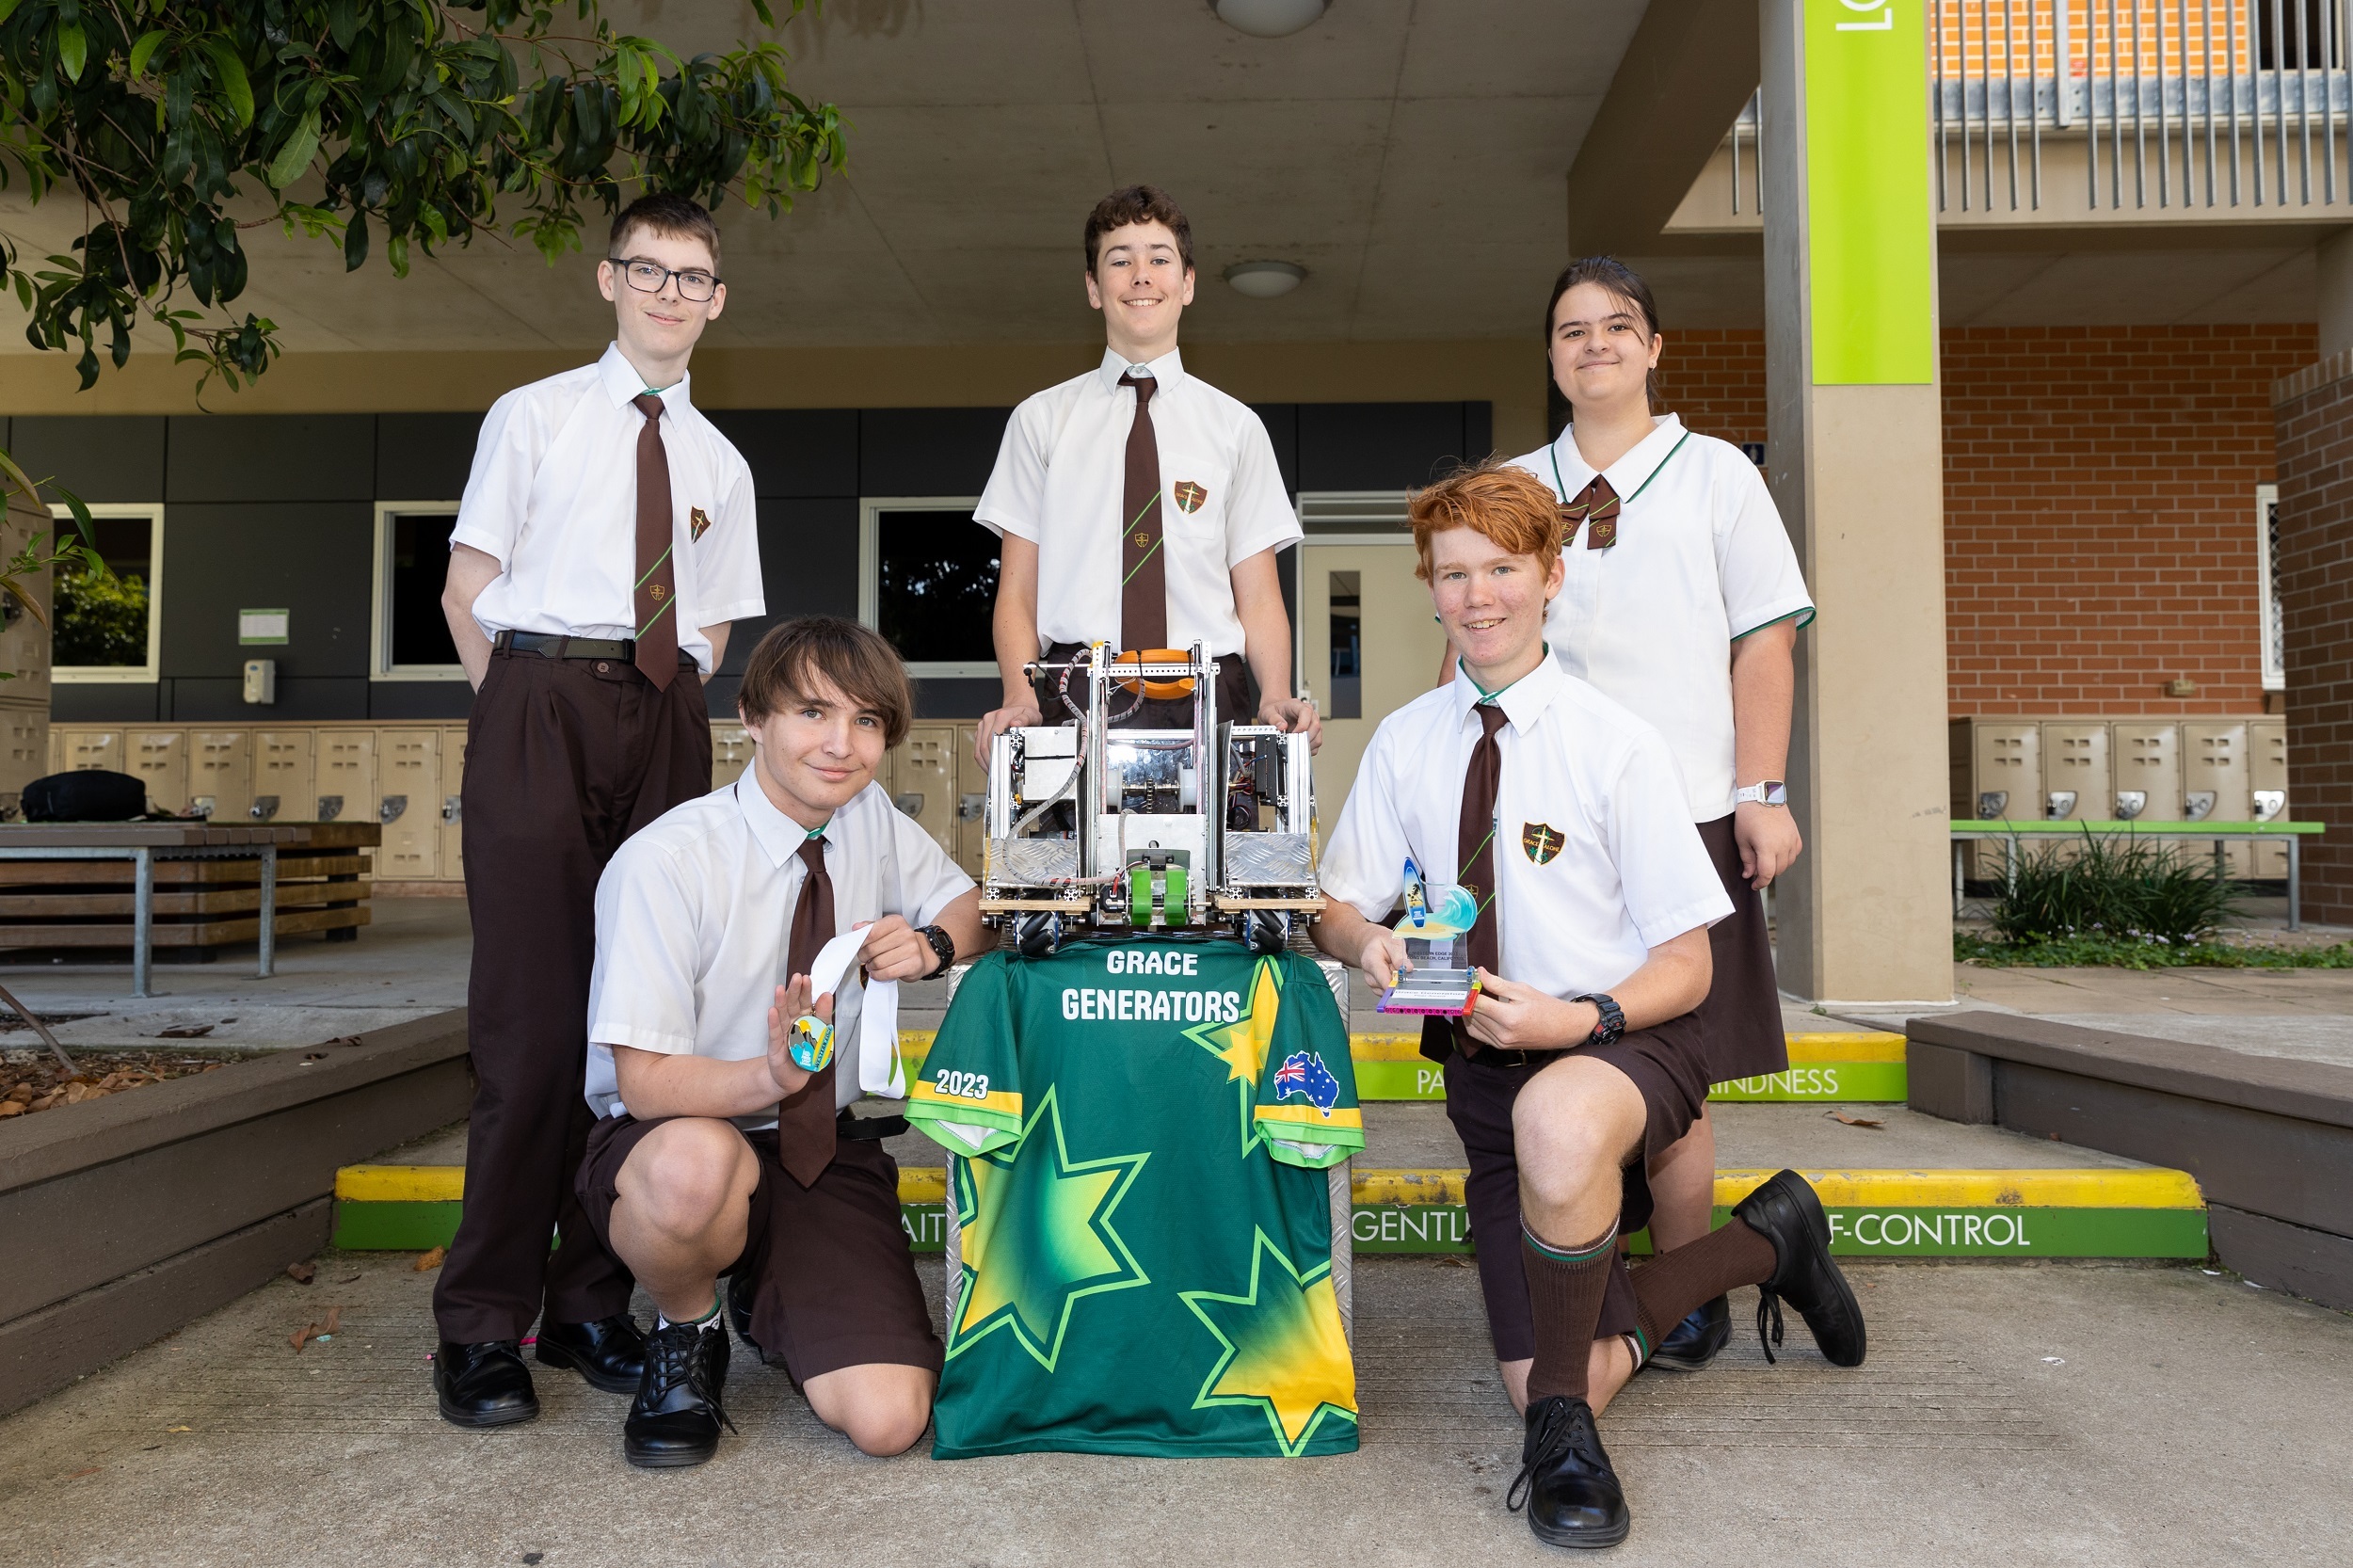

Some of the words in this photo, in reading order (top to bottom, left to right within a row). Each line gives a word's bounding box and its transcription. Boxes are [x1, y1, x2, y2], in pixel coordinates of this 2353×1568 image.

[1835, 0, 1893, 31] L
[1523, 838, 1540, 846] GRACE
[1107, 951, 1198, 976] GRACE
[1062, 988, 1241, 1023] GENERATORS
[935, 1068, 989, 1099] 2023
[1709, 1068, 1839, 1095] INDNESS
[1351, 1210, 1471, 1241] GENTL
